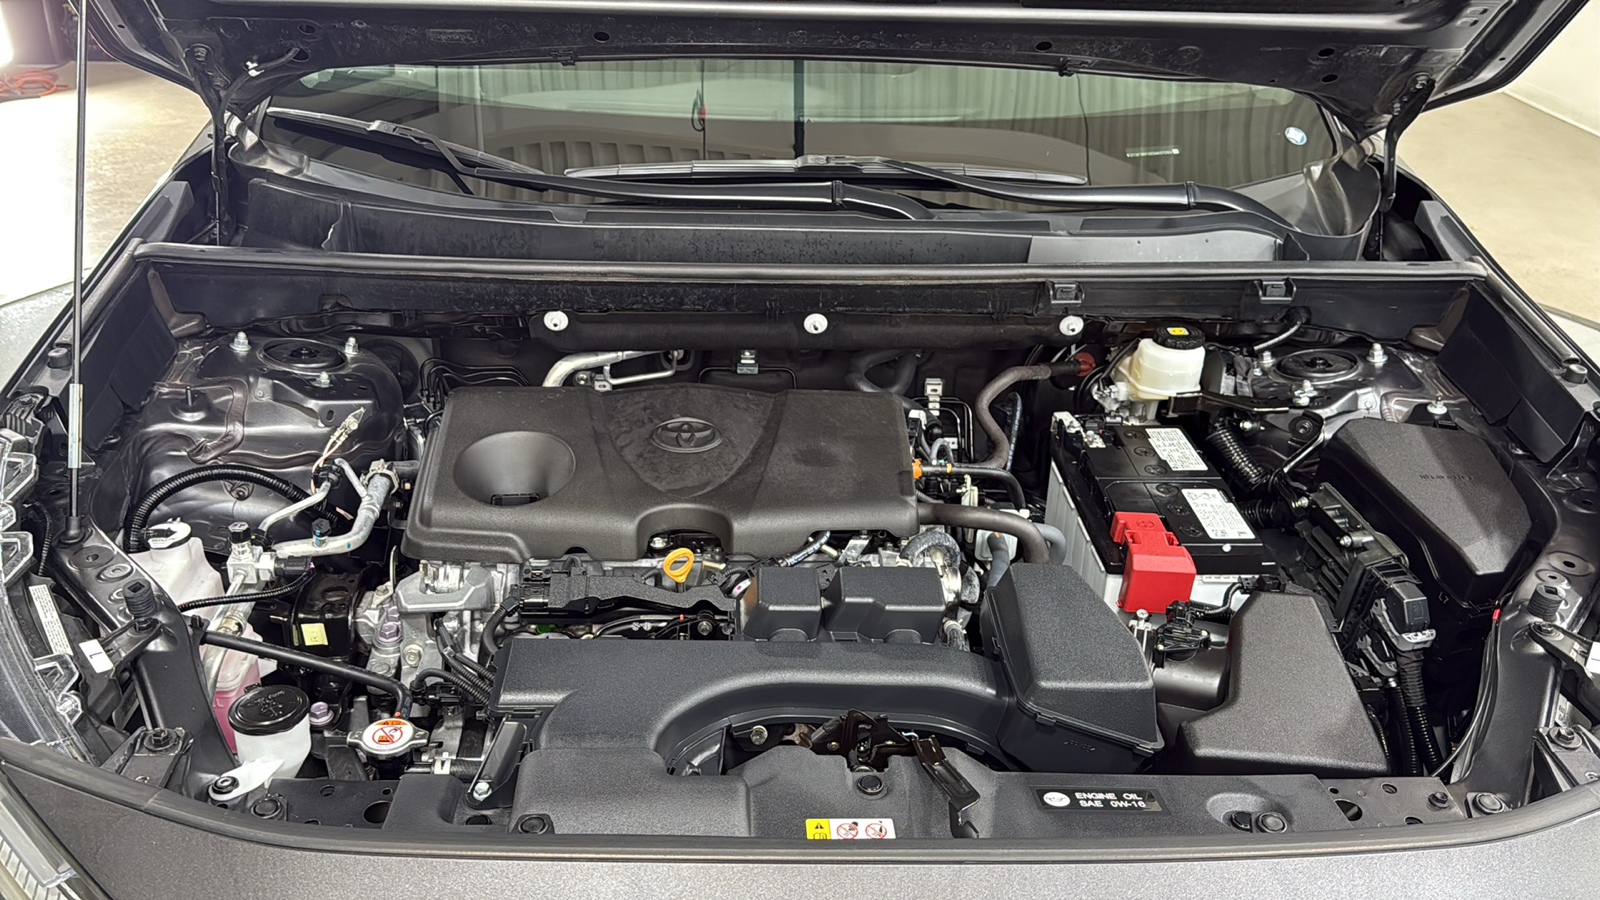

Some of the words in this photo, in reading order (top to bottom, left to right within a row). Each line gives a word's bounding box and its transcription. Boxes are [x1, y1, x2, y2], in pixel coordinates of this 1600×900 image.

[1074, 792, 1118, 800] ENGINE
[1122, 793, 1143, 801] OIL
[1079, 800, 1104, 808] SAE
